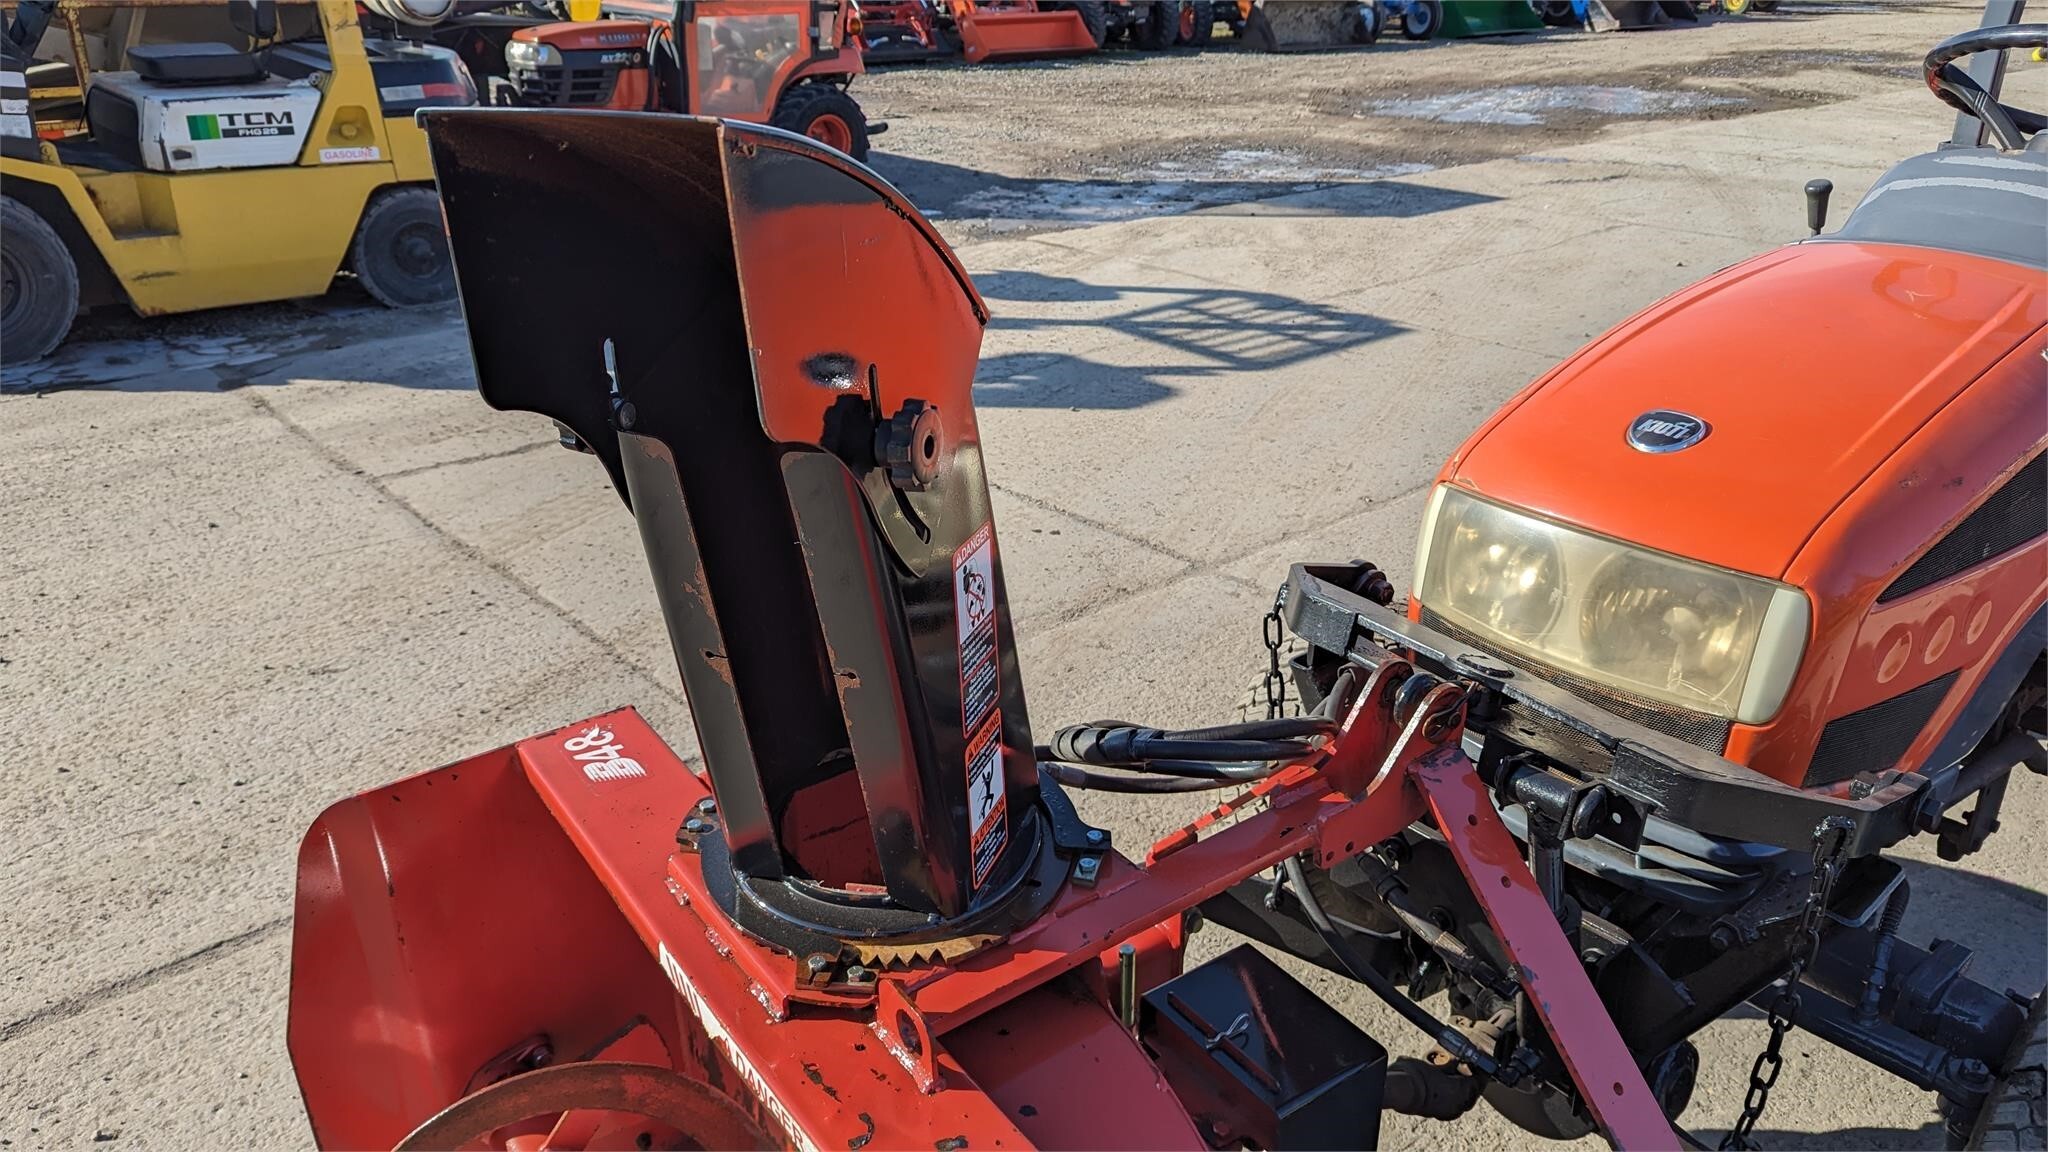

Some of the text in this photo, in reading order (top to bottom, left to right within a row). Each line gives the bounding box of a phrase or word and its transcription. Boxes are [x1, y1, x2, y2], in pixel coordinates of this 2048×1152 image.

[218, 111, 293, 126] TCM
[323, 148, 375, 160] GASOLINE
[961, 526, 990, 557] DANGER
[972, 713, 1000, 750] WARNING
